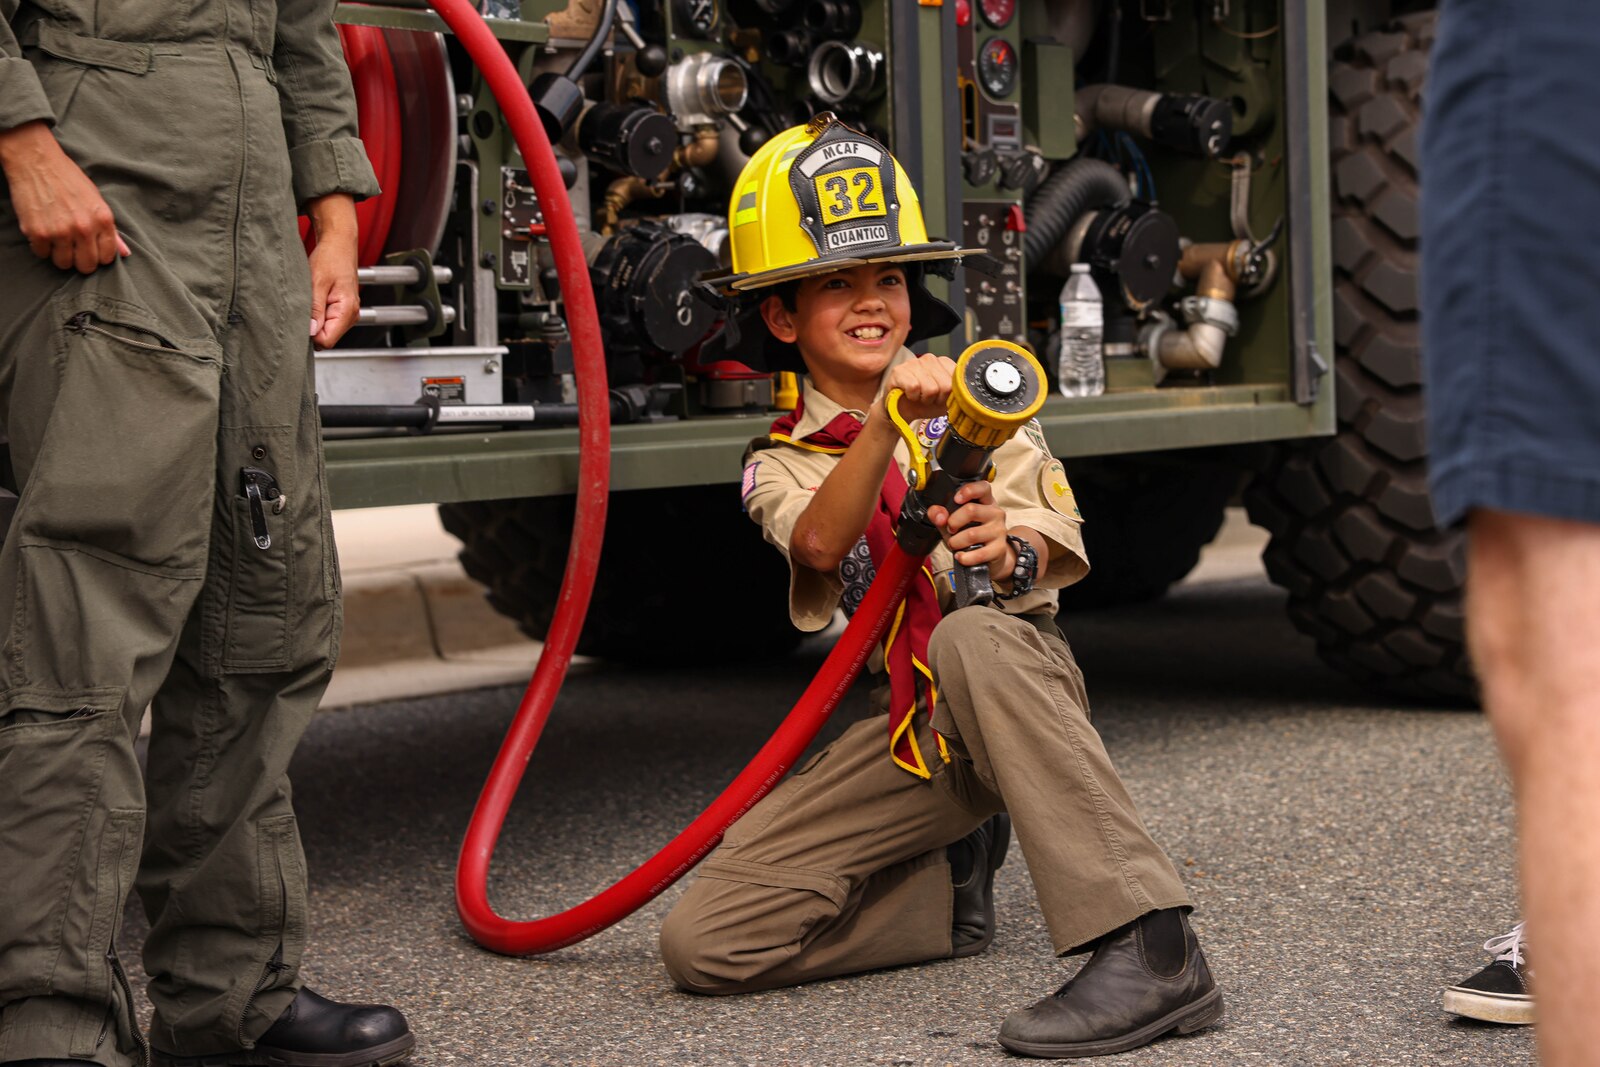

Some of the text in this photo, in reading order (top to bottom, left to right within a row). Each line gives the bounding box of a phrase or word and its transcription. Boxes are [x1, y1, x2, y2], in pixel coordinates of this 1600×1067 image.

[823, 143, 859, 160] MCAF
[825, 172, 879, 217] 32
[831, 227, 885, 245] QUANTICO
